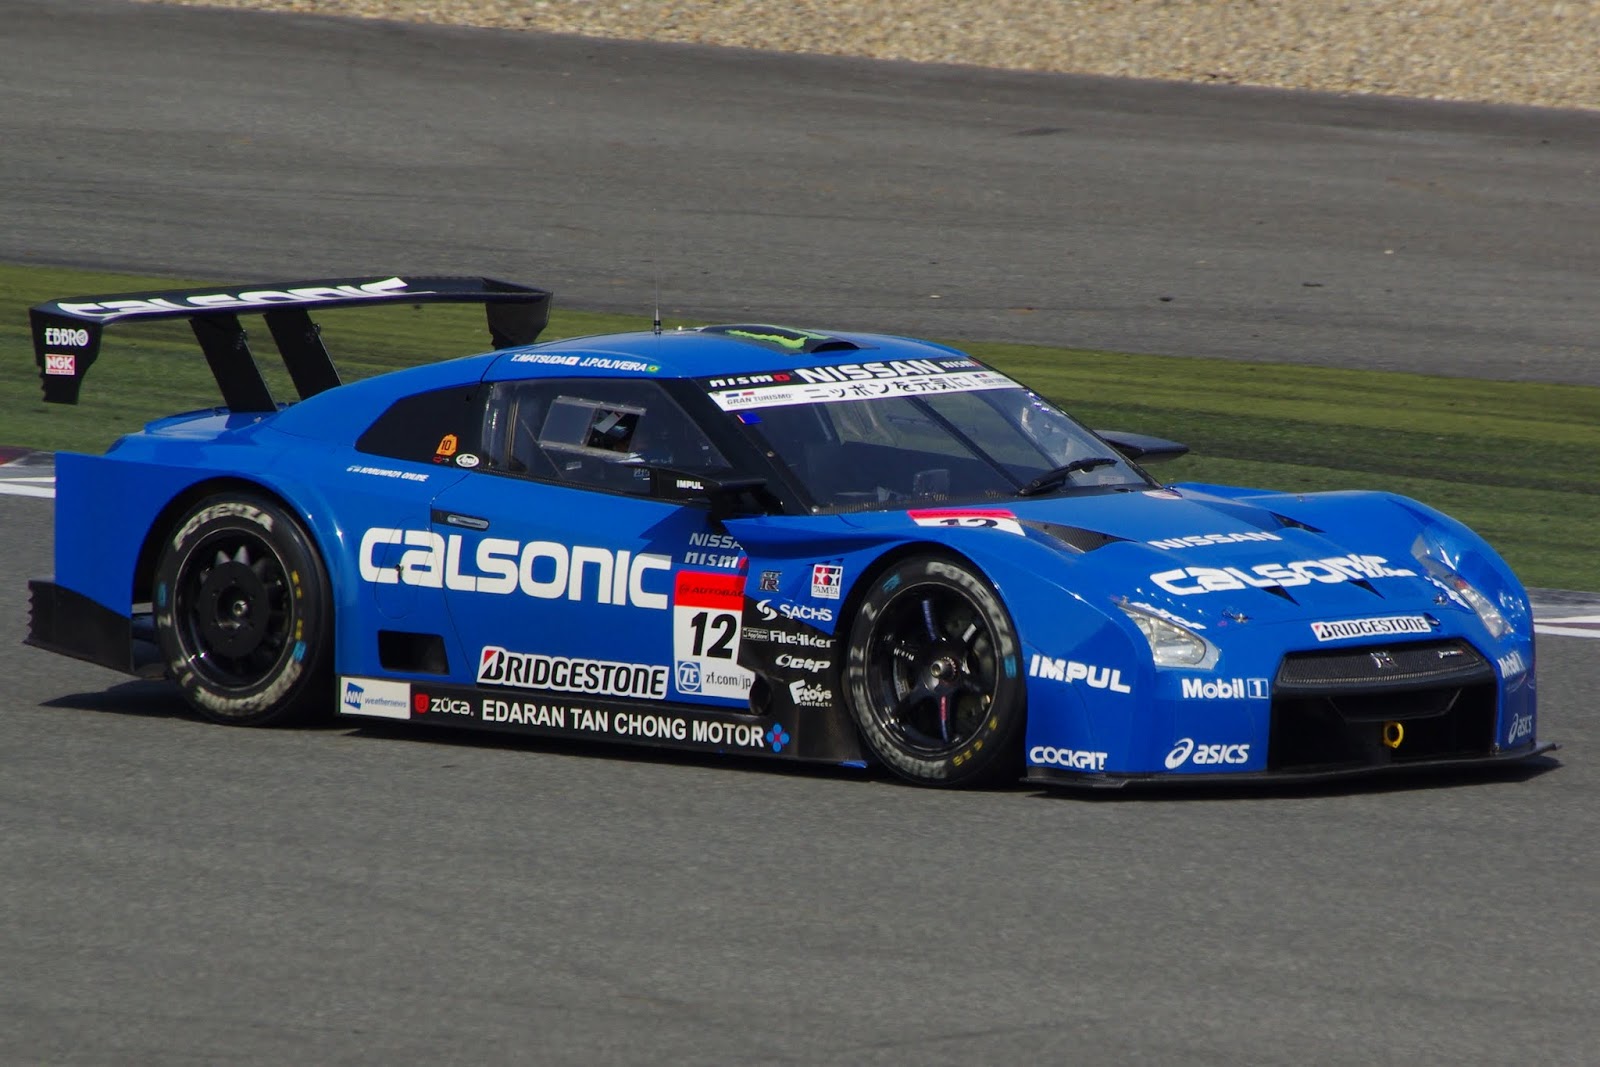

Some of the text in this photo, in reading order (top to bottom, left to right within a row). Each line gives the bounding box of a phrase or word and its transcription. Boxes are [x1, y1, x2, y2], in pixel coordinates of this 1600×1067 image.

[46, 355, 73, 370] NGK
[794, 359, 946, 384] NISSAN
[727, 394, 792, 405] GRAN TURISMO
[676, 480, 704, 490] IMPUL
[688, 532, 744, 550] NISSA
[1147, 532, 1283, 550] NISSAN
[812, 585, 839, 596] TAMIYA
[779, 604, 833, 622] SACHS
[690, 611, 737, 660] 12
[1314, 616, 1429, 639] BRIDGESTONE
[481, 648, 666, 696] BRIDGESTONE
[680, 667, 699, 686] ZF
[706, 672, 751, 690] zf.com/jp
[1029, 654, 1131, 694] IMPUL
[1182, 678, 1245, 698] Mobil
[365, 696, 407, 709] weathernews
[482, 699, 765, 748] EDARAN TAN CHONG MOTOR
[1029, 745, 1108, 771] COCKPIT
[1193, 744, 1250, 765] asics
